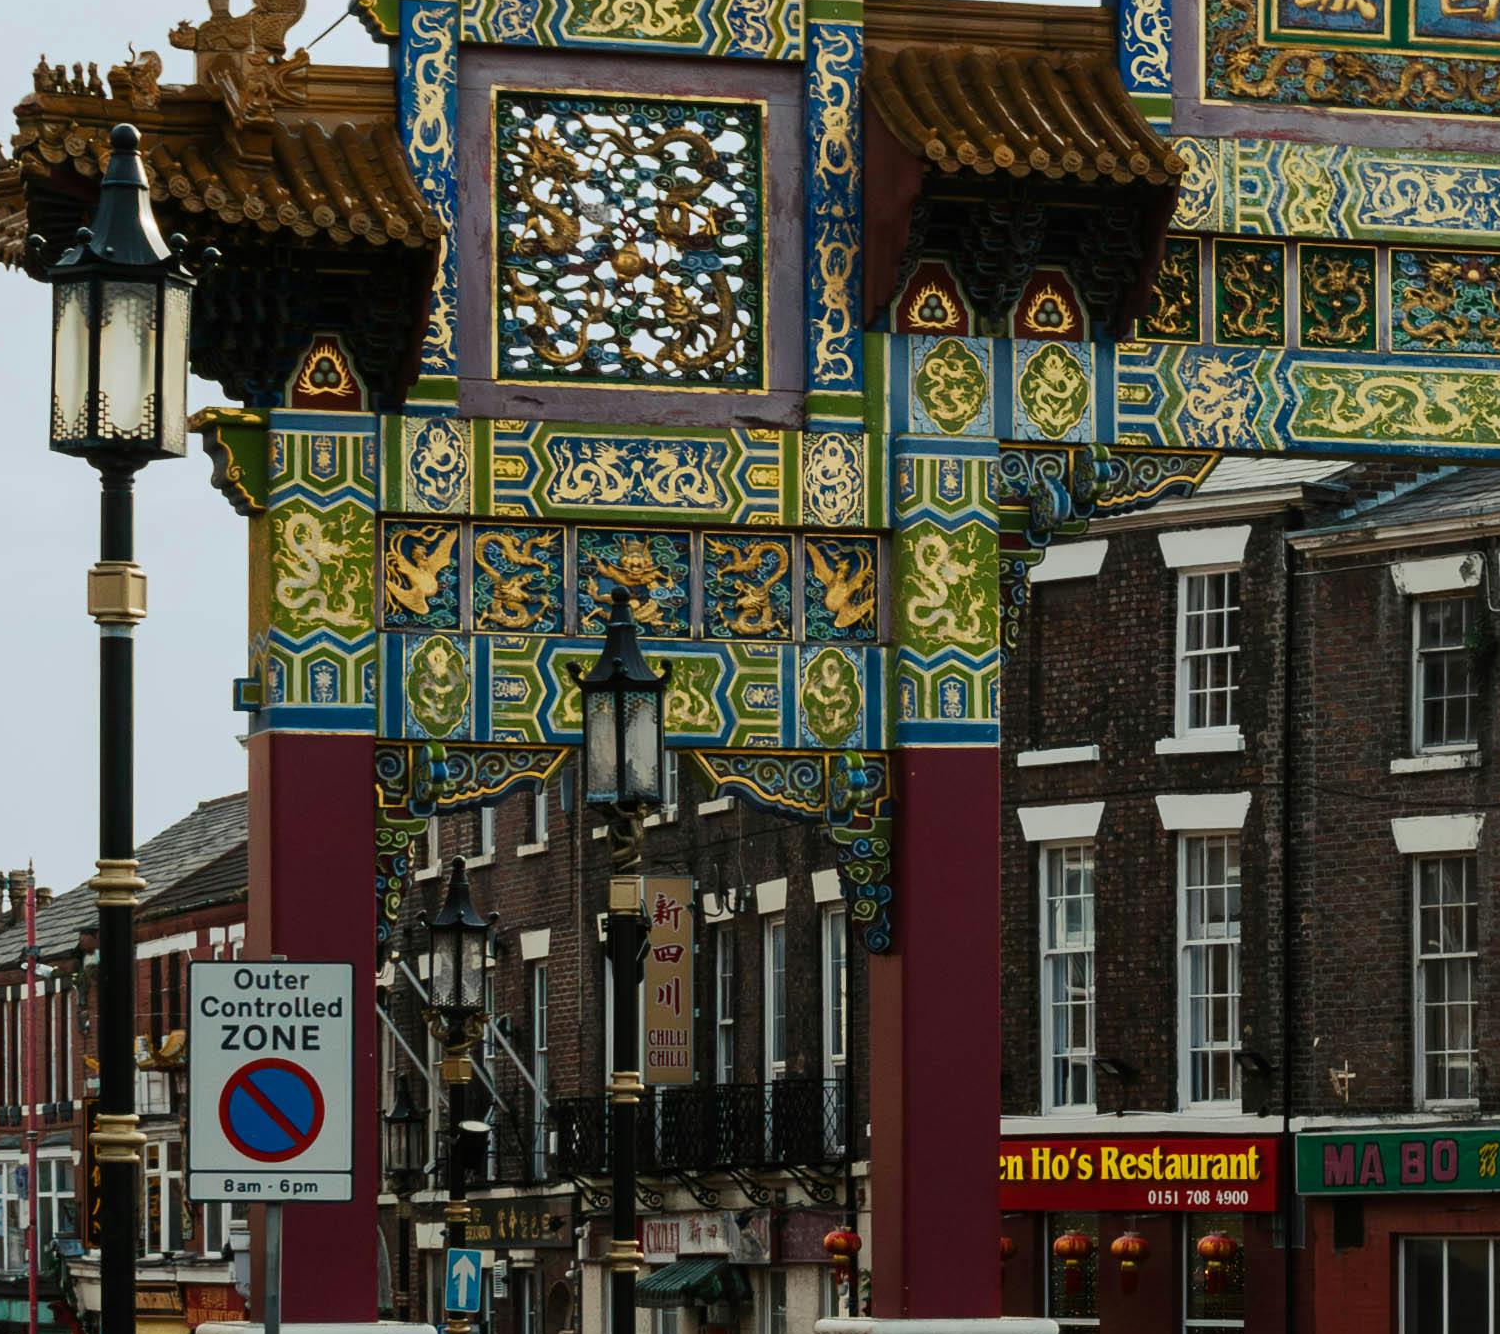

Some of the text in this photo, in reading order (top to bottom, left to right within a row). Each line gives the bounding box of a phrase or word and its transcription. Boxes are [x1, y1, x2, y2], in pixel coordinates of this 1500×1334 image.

[653, 894, 685, 1017] 新四川
[234, 968, 310, 990] Outer
[200, 996, 343, 1018] Controlled
[220, 1024, 321, 1051] ZONE
[649, 1029, 688, 1046] CHILLI
[649, 1050, 689, 1067] CHILLI
[1000, 1145, 1260, 1180] en Ho's Restaurant
[1322, 1140, 1387, 1188] MA
[1399, 1137, 1459, 1184] BO
[1148, 1190, 1249, 1205] 0151 708 4900
